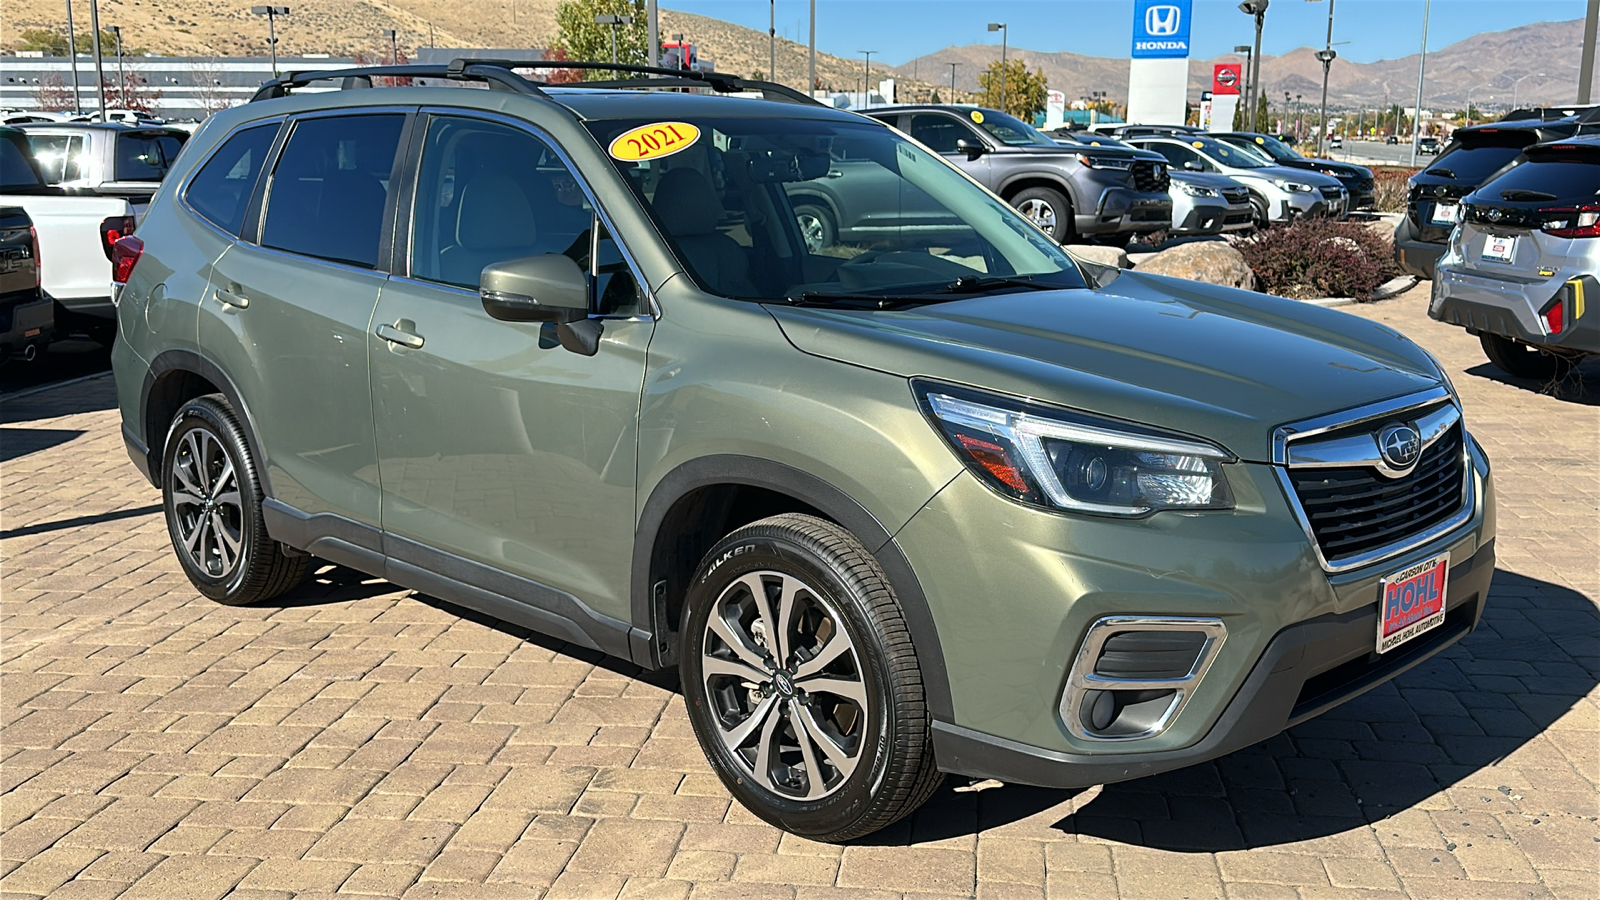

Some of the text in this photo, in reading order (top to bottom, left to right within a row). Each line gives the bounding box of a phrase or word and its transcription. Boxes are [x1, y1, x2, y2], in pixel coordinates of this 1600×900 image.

[1136, 41, 1187, 50] HONDA
[627, 125, 686, 157] 2021
[701, 544, 756, 584] FALKEN
[1400, 559, 1437, 581] CARSON CITY
[1386, 571, 1438, 621] HOHL
[1382, 613, 1443, 650] MICHAEL HOHL AUTOMOTIVE
